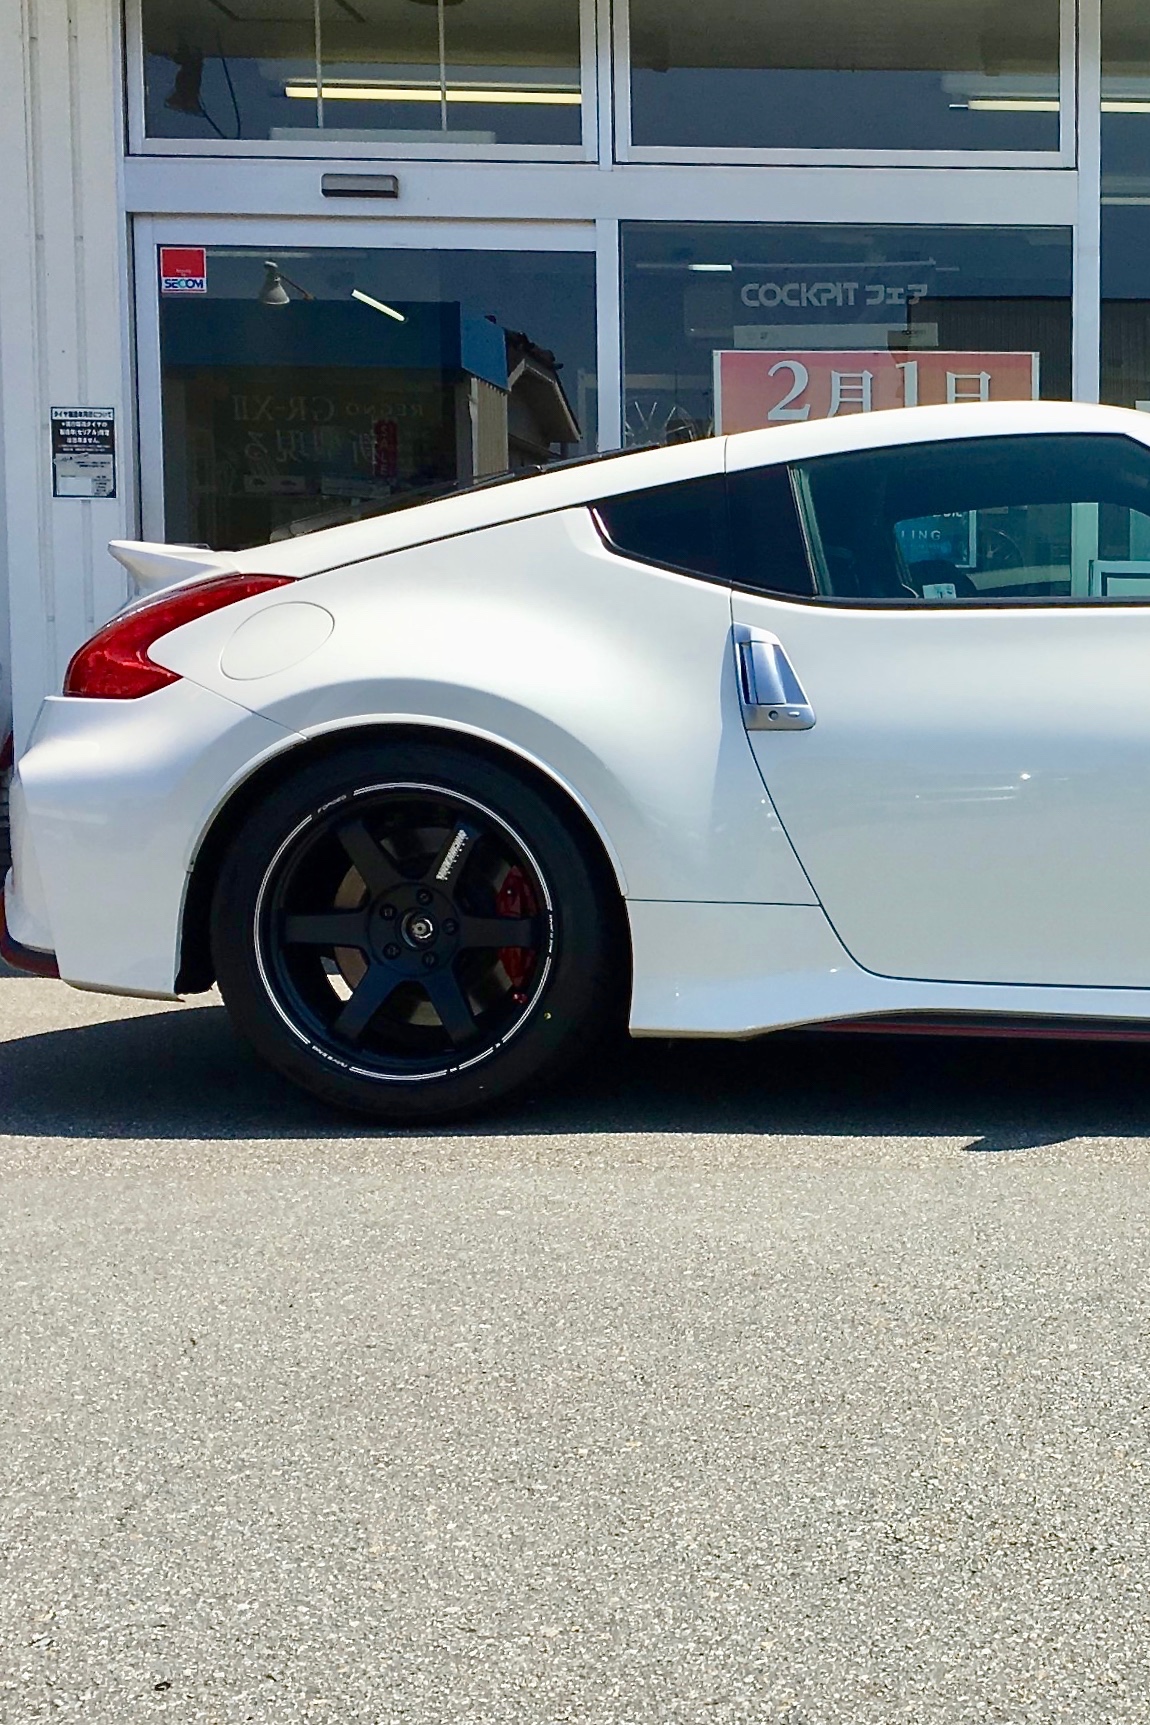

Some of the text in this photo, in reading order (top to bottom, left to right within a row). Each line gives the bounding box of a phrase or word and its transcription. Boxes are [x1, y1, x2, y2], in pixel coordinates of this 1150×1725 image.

[164, 279, 203, 289] SECOM
[741, 282, 928, 307] COCKPIT フェア
[767, 360, 992, 421] 2月1日
